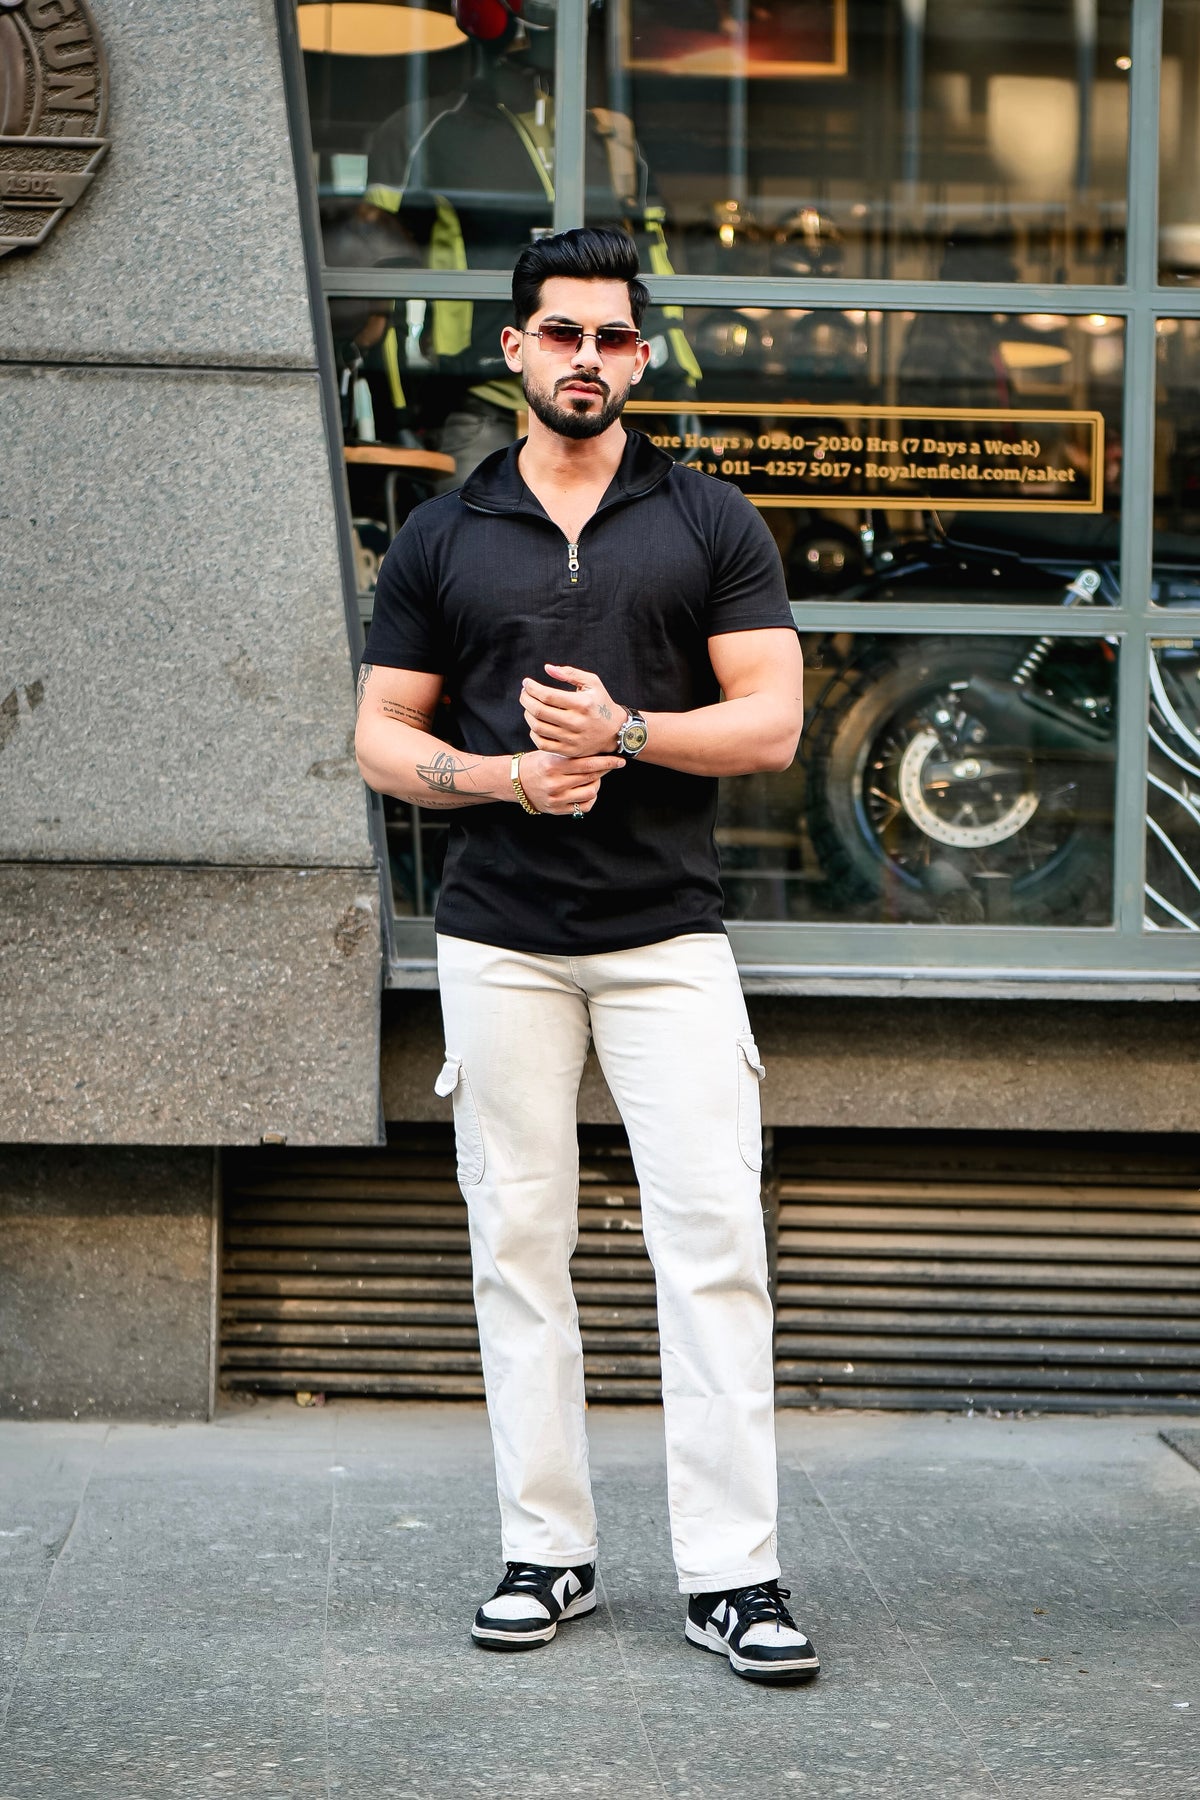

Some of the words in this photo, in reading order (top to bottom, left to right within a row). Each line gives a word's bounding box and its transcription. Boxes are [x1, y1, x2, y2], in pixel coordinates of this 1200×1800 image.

[25, 0, 96, 111] GUN
[6, 174, 57, 195] 1901
[646, 433, 681, 448] ore
[684, 433, 740, 449] Hours
[866, 437, 899, 453] Hrs
[901, 437, 920, 455] (7
[923, 438, 967, 457] Days
[969, 442, 981, 455] a
[984, 440, 1041, 458] Week)
[810, 461, 852, 478] 5017
[865, 462, 1075, 483] Royalenfield.com/saket
